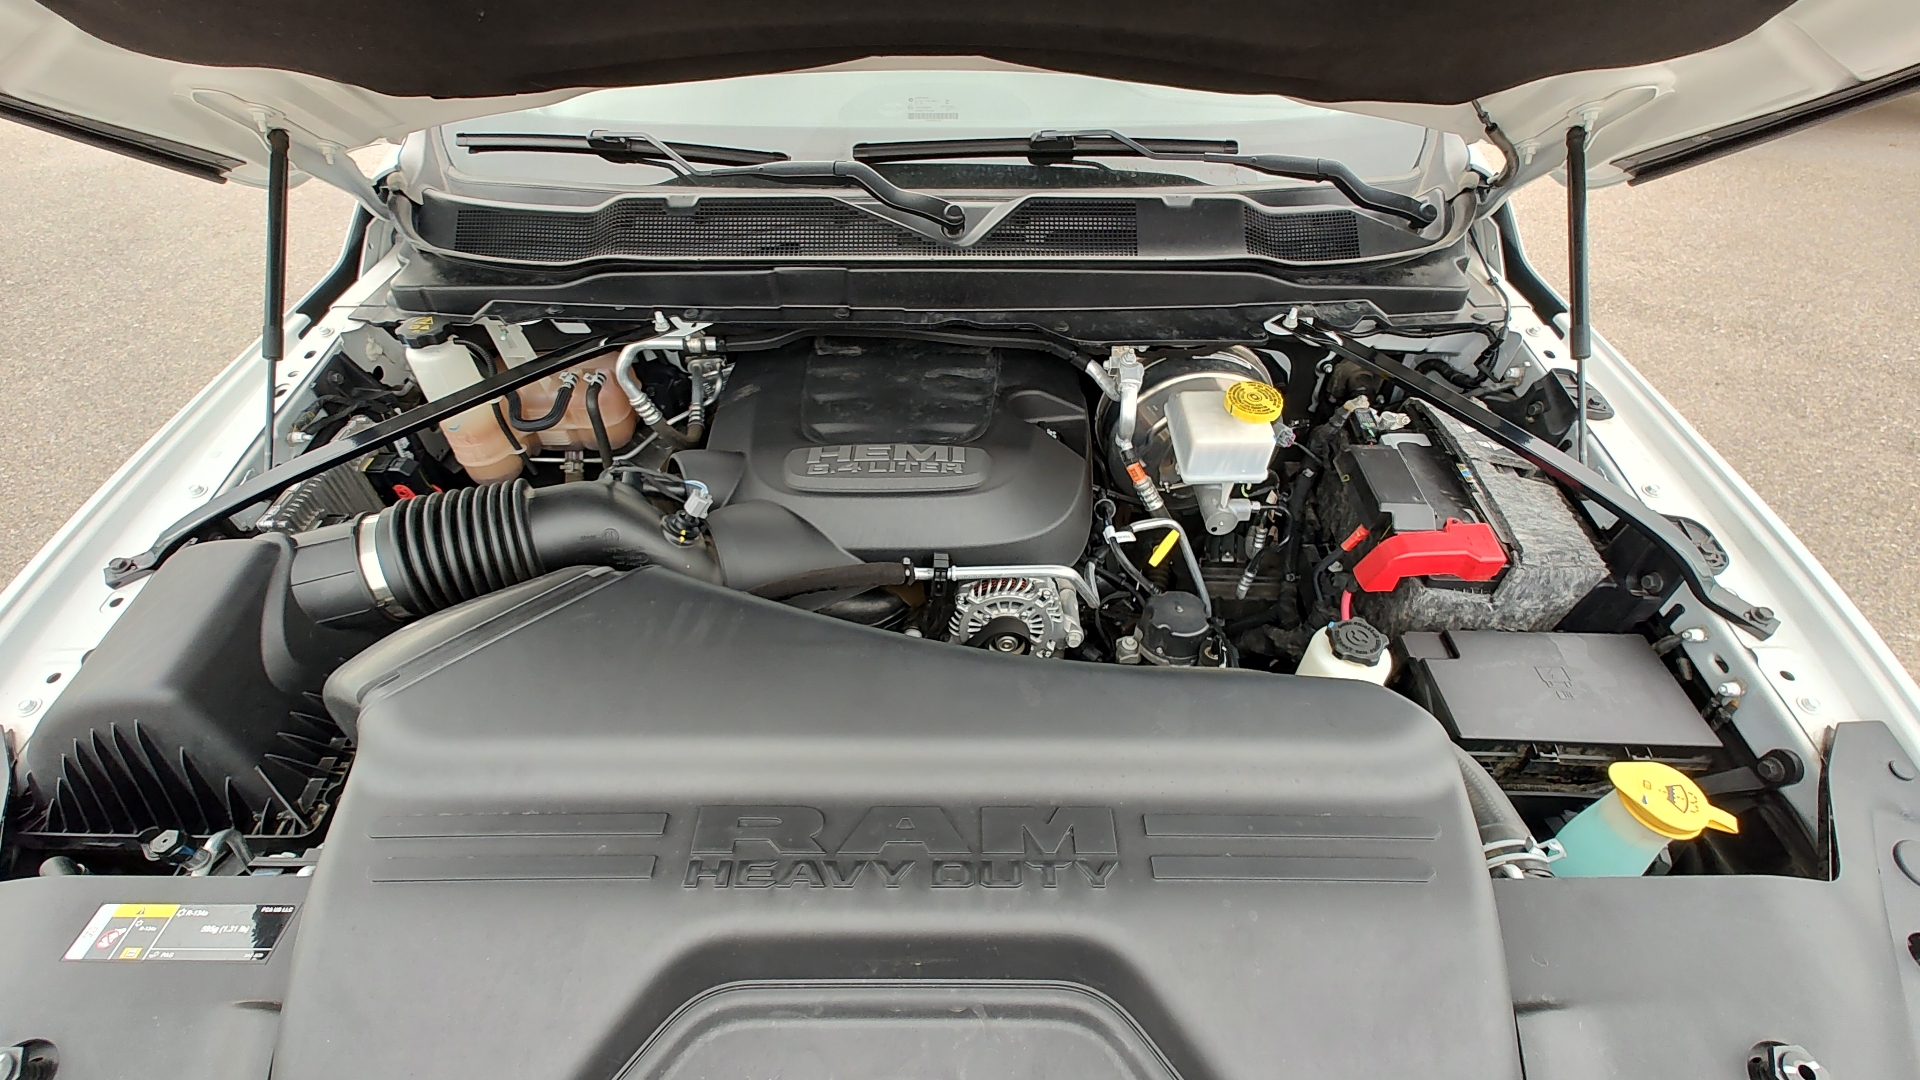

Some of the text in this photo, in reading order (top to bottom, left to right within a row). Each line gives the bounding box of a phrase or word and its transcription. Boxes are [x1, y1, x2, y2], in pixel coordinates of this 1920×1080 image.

[806, 444, 966, 464] HEMI
[807, 461, 964, 475] 6.4 LITER
[690, 805, 1118, 855] RAM
[682, 860, 1119, 889] HEAVY DUTY
